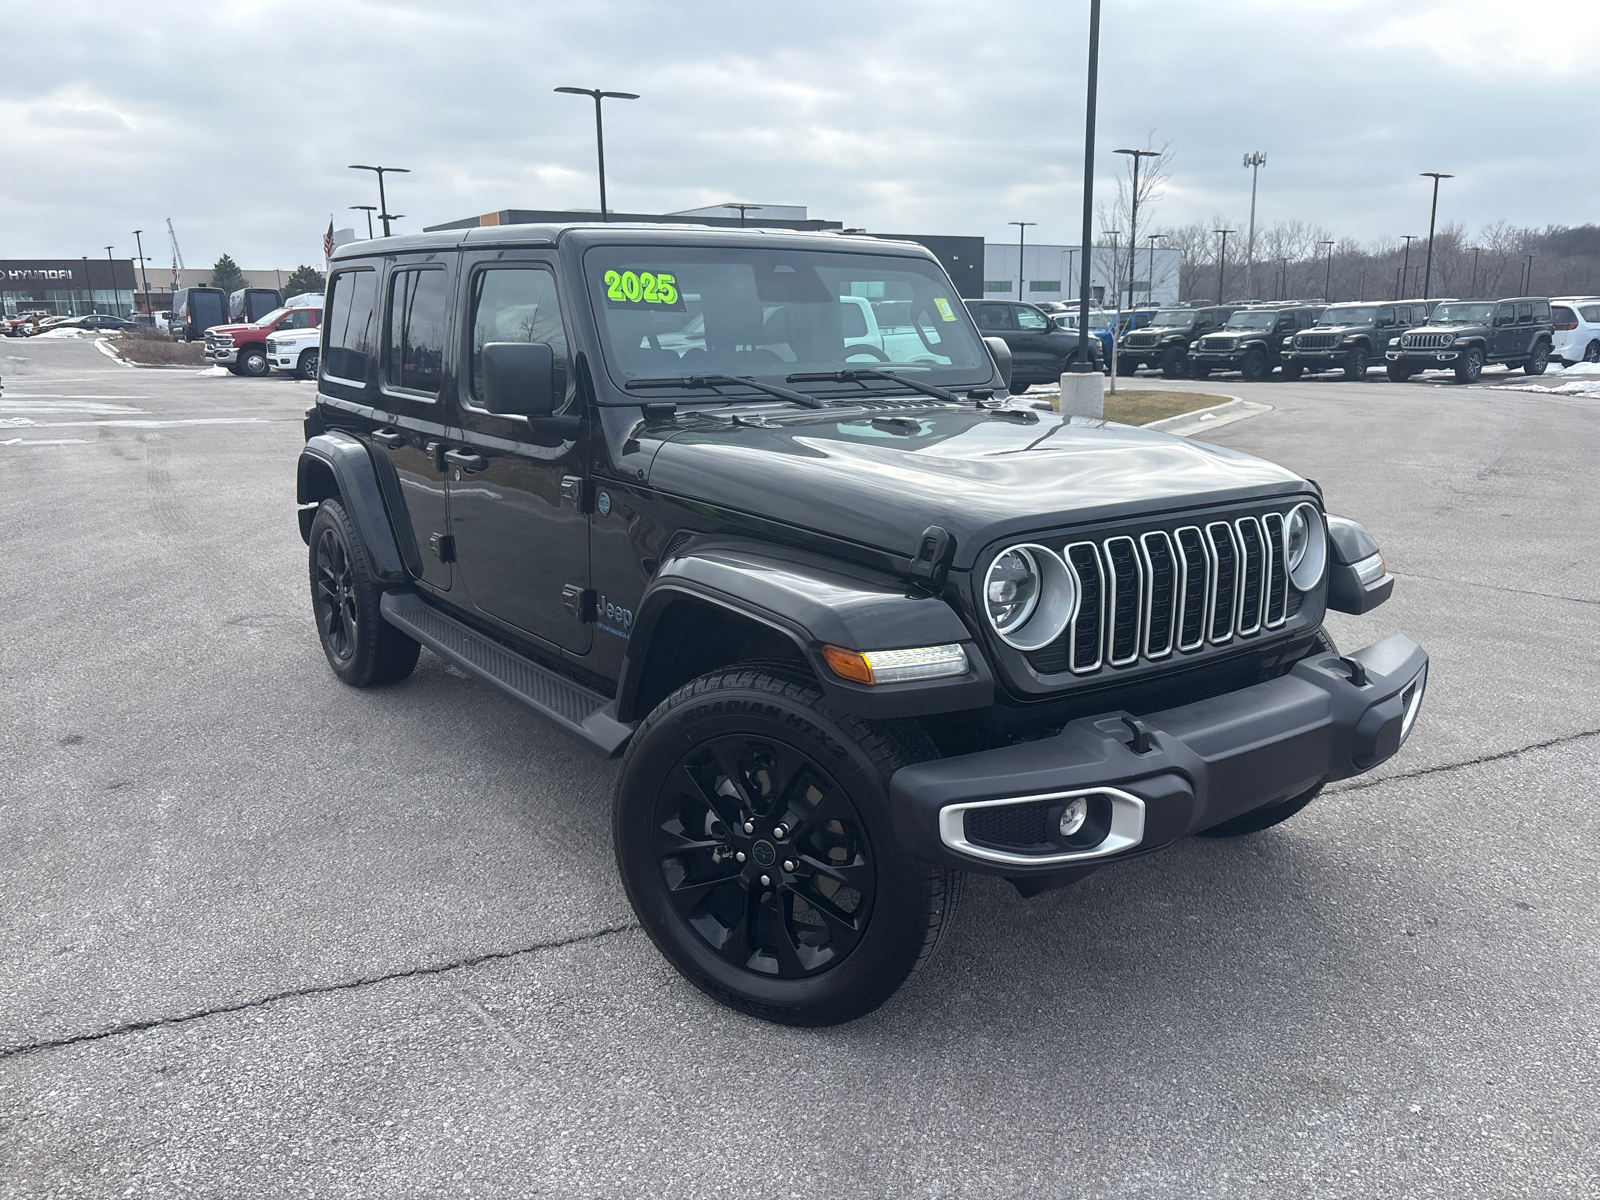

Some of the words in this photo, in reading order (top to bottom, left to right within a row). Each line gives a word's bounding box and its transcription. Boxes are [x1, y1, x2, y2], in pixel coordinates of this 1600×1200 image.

[8, 269, 73, 280] HYUNDAI
[604, 269, 678, 305] 2025
[596, 595, 633, 630] Jeep
[683, 700, 783, 723] ROADIAN
[784, 713, 849, 761] HTX2
